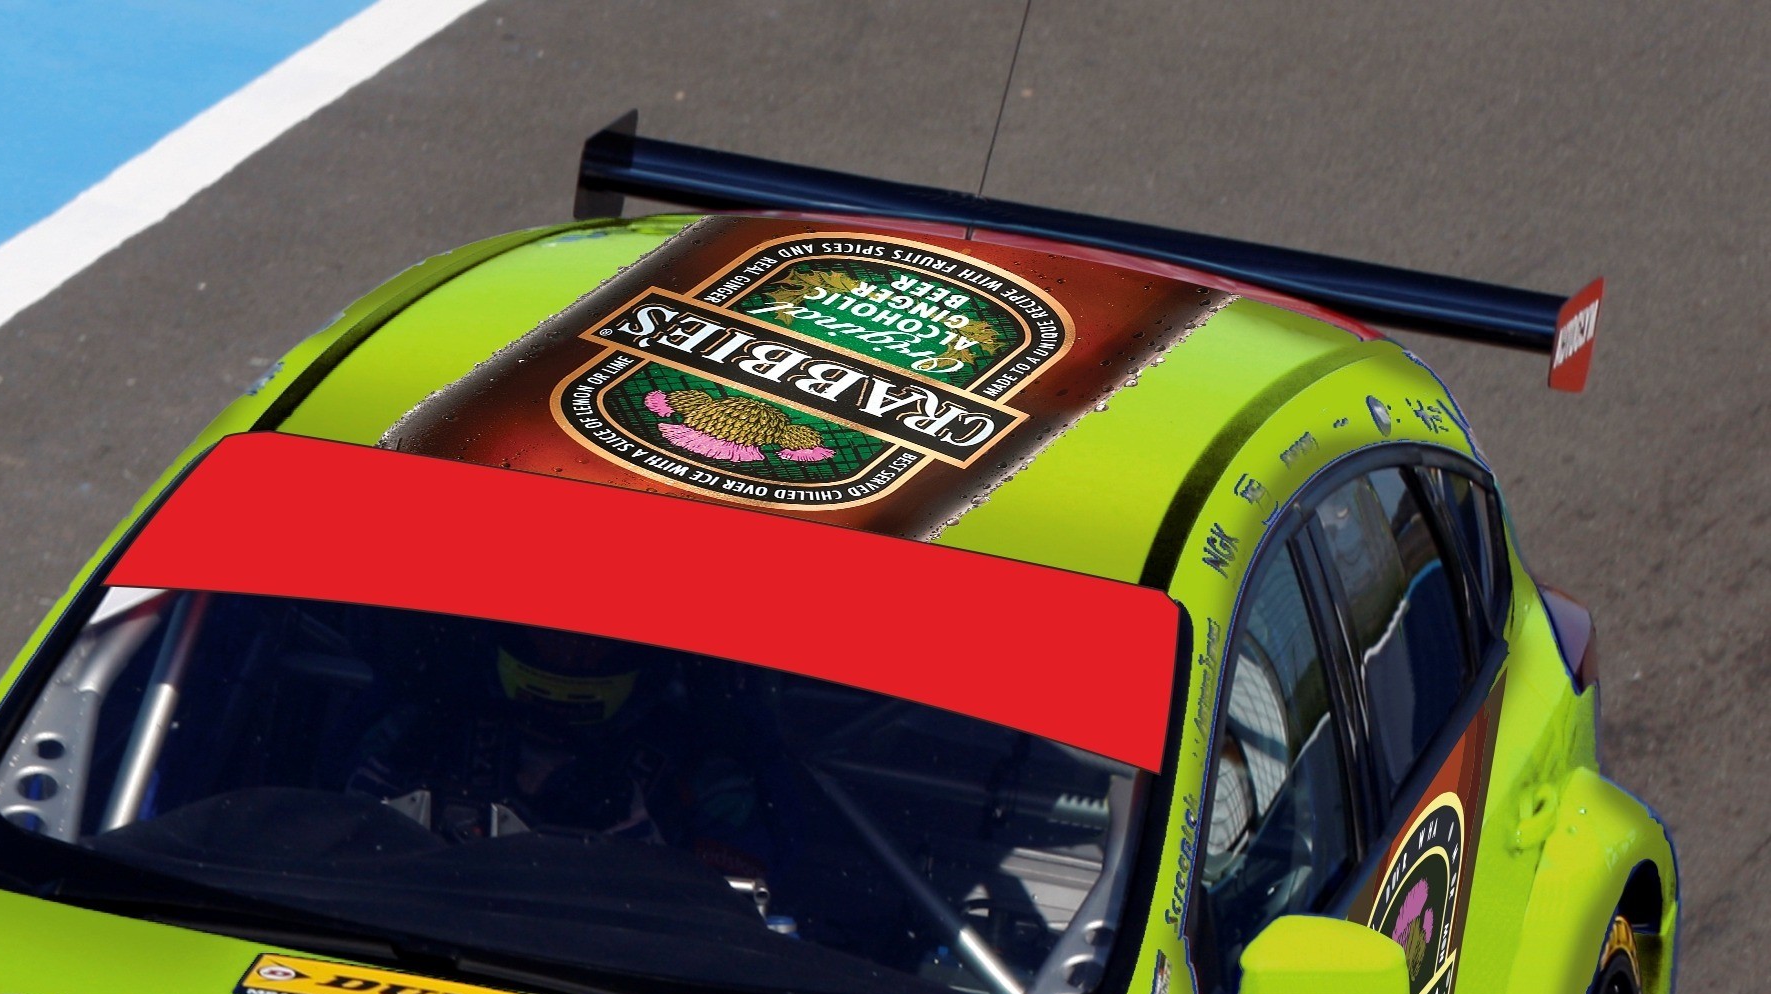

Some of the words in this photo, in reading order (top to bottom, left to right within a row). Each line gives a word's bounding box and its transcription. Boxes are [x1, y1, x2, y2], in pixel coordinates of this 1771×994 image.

[777, 243, 814, 258] AND
[823, 243, 884, 256] SPICES
[743, 256, 779, 274] REAL
[891, 249, 958, 274] FRUITS
[703, 275, 751, 303] GINGER
[957, 269, 1004, 292] WITH
[890, 274, 970, 310] BEER
[850, 281, 970, 329] GINGER
[1000, 288, 1049, 319] RECIPE
[803, 286, 979, 351] ALCOHOLIC
[746, 300, 964, 373] Original
[1033, 320, 1059, 357] UNIQUE
[606, 355, 634, 375] LIME
[1011, 362, 1031, 376] TO
[1026, 356, 1041, 365] A
[587, 372, 610, 385] OR
[617, 303, 996, 449] CRABBIE'S
[983, 373, 1018, 397] MADE
[572, 385, 595, 416] LEMON
[579, 418, 603, 429] OF
[593, 428, 635, 452] SLICE
[631, 448, 648, 458] A
[892, 452, 919, 473] BEST
[643, 454, 690, 476] WITH
[688, 470, 720, 486] ICE
[722, 479, 768, 497] OVER
[848, 471, 896, 497] SERVED
[774, 488, 843, 501] CHILLED
